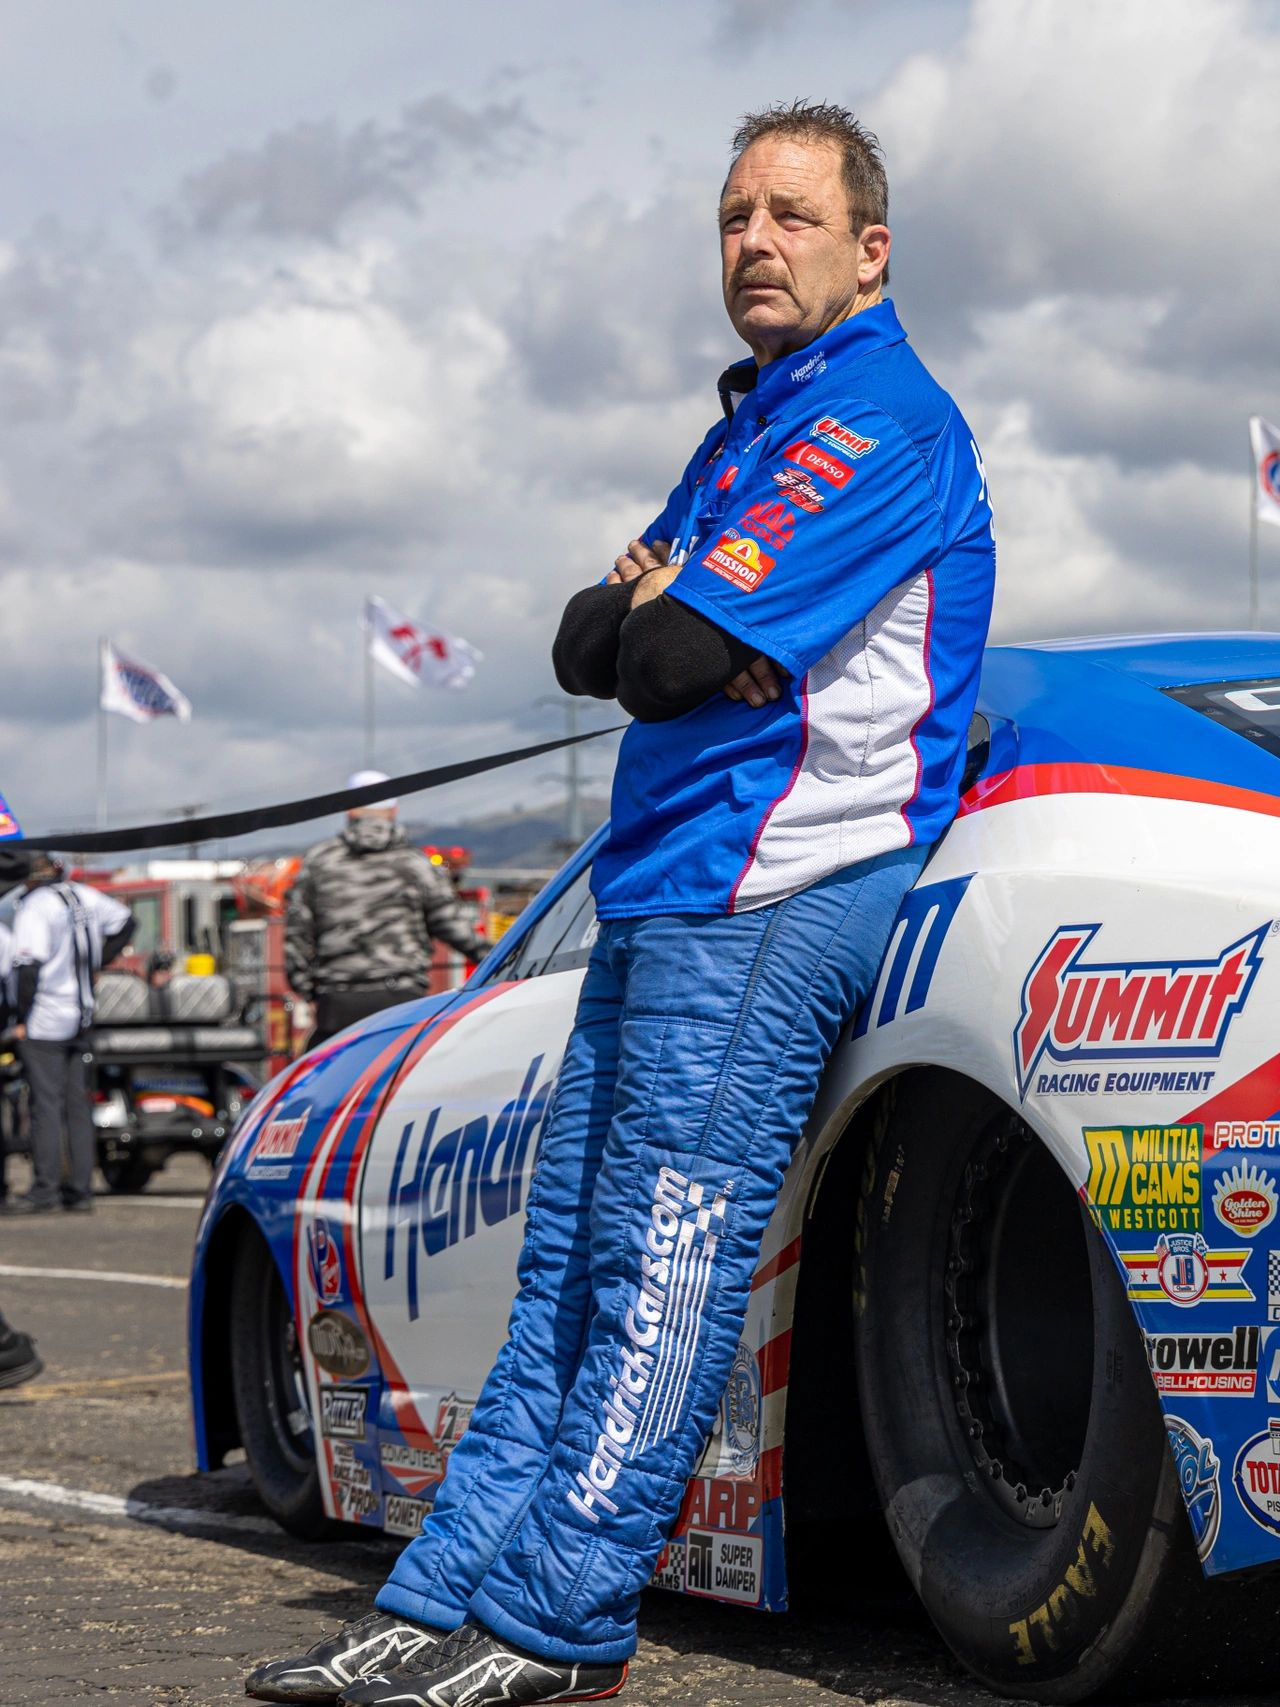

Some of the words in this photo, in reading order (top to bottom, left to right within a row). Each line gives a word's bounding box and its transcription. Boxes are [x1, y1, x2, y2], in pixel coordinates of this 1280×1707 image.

[806, 453, 845, 479] DENSO
[736, 516, 786, 551] TOOLS
[744, 499, 796, 543] MAC
[710, 549, 758, 584] MISSION
[1020, 936, 1247, 1072] SUMMIT
[1036, 1072, 1100, 1094] RACING
[1103, 1071, 1216, 1092] EQUIPMENT
[1132, 1128, 1200, 1163] MILITIA
[1131, 1162, 1200, 1205] CAMS
[1224, 1198, 1267, 1212] Golden
[1229, 1208, 1264, 1219] Shine
[1109, 1208, 1200, 1229] WESTCOTT
[566, 1166, 690, 1524] HendrickCars.com
[1157, 1376, 1253, 1390] BELLHOUSING
[690, 1479, 761, 1531] ARP
[720, 1543, 753, 1568] SUPER
[651, 1572, 680, 1590] CAMS
[715, 1567, 756, 1593] DAMPER
